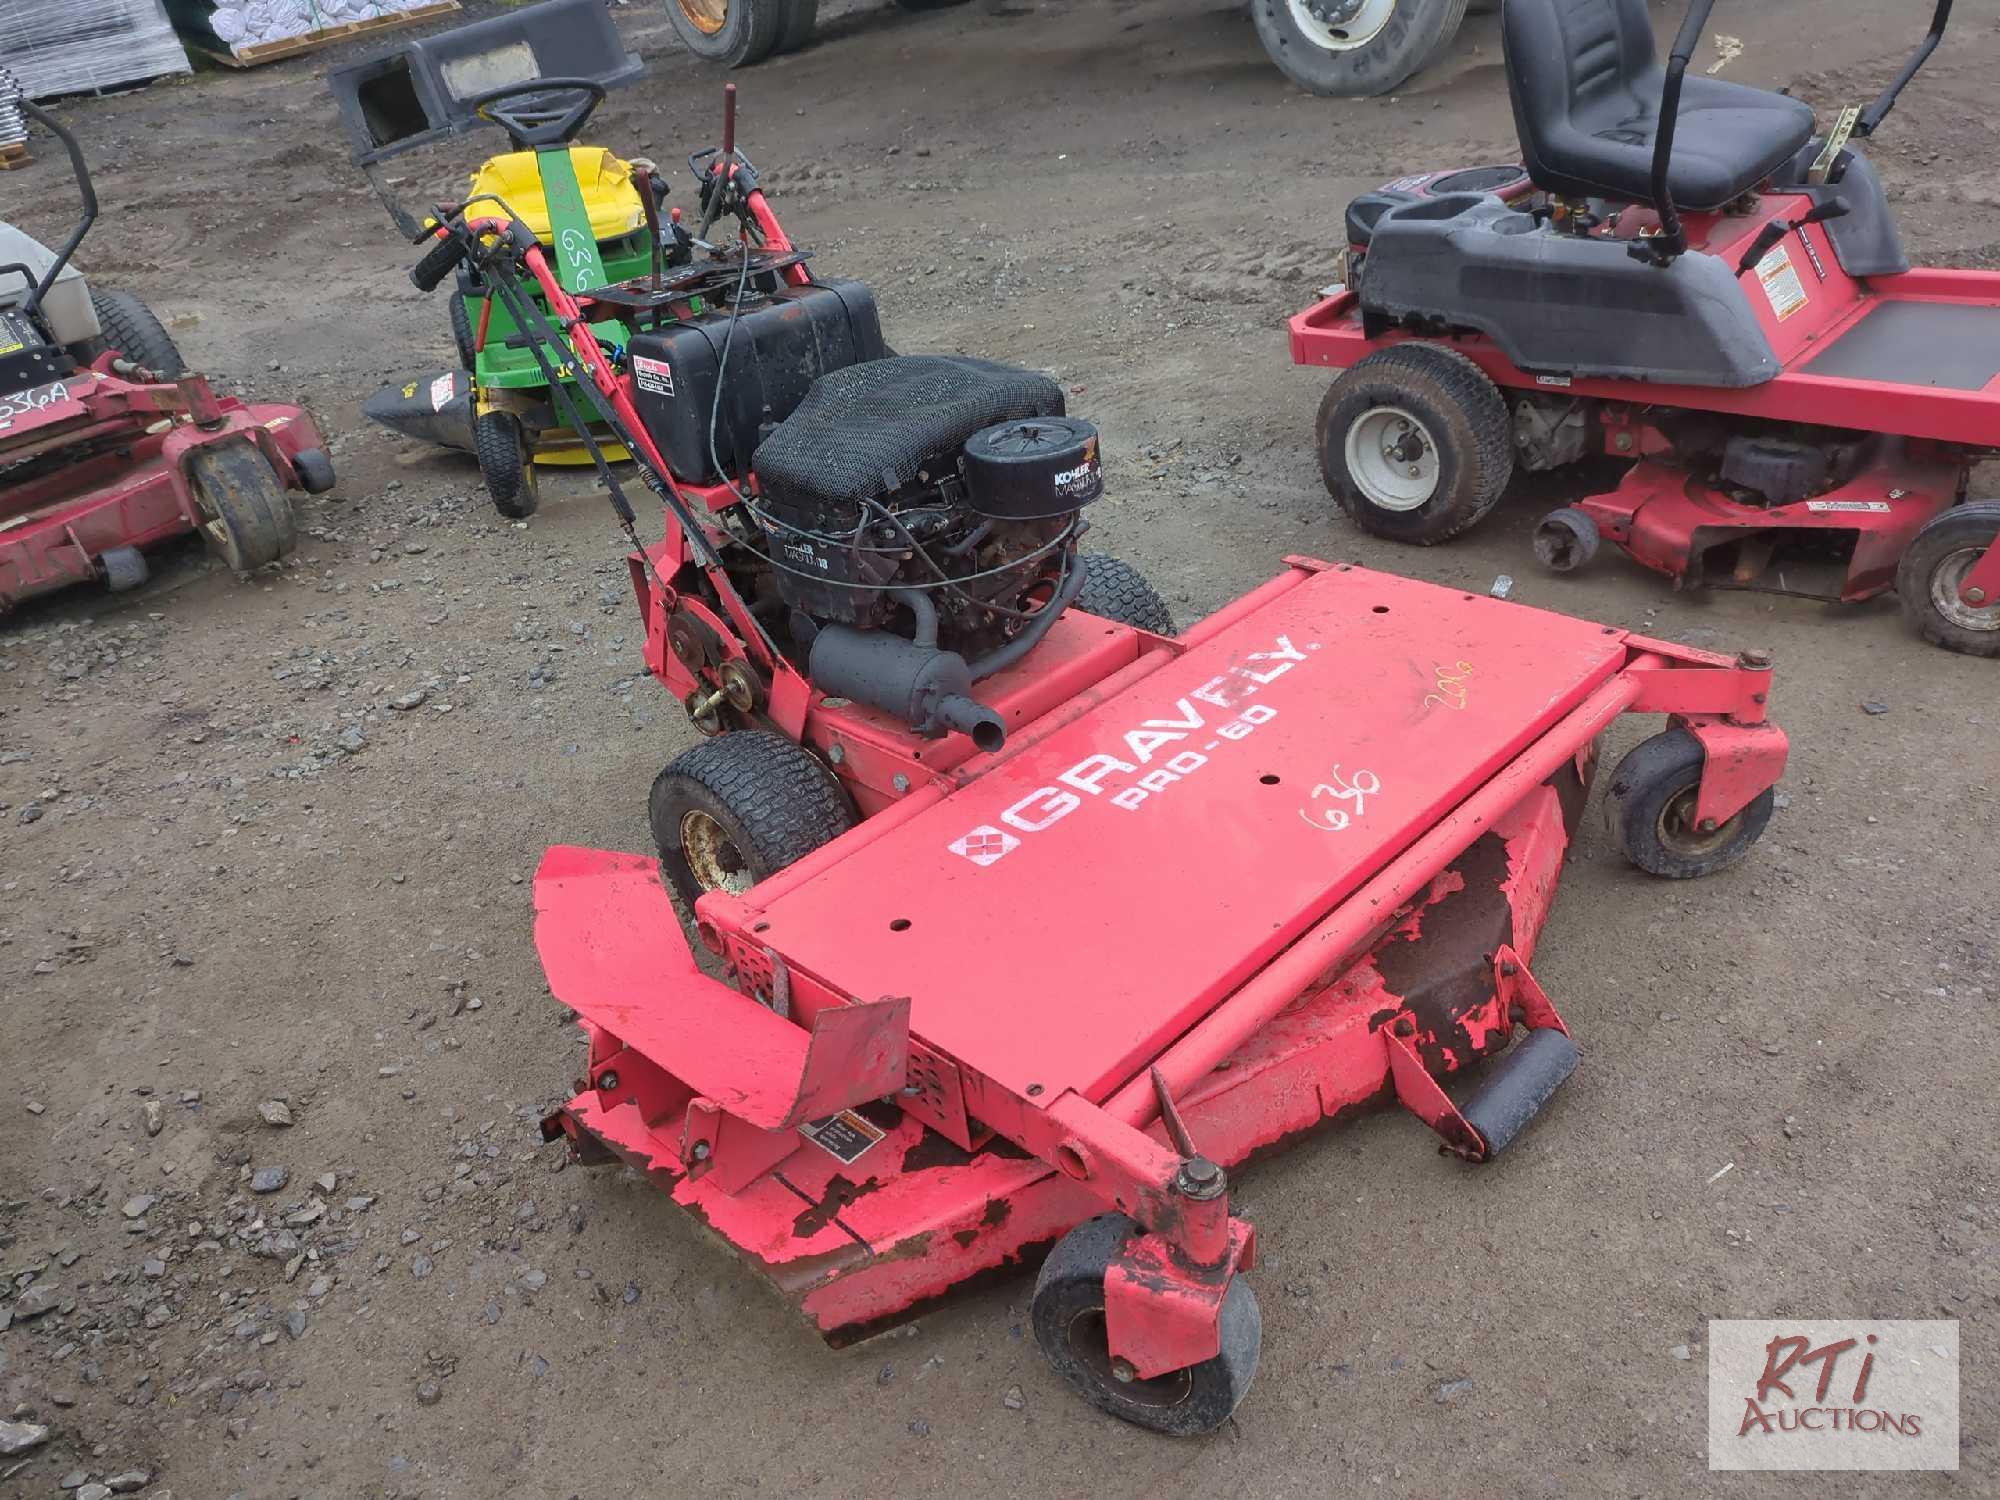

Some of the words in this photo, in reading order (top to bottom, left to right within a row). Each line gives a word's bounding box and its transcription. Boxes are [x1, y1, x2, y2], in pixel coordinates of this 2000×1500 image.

[562, 228, 595, 291] 636
[1054, 462, 1091, 486] KOHLER
[1000, 634, 1308, 833] GRAVELY
[1110, 704, 1278, 811] PRO-60
[1299, 763, 1381, 831] 636
